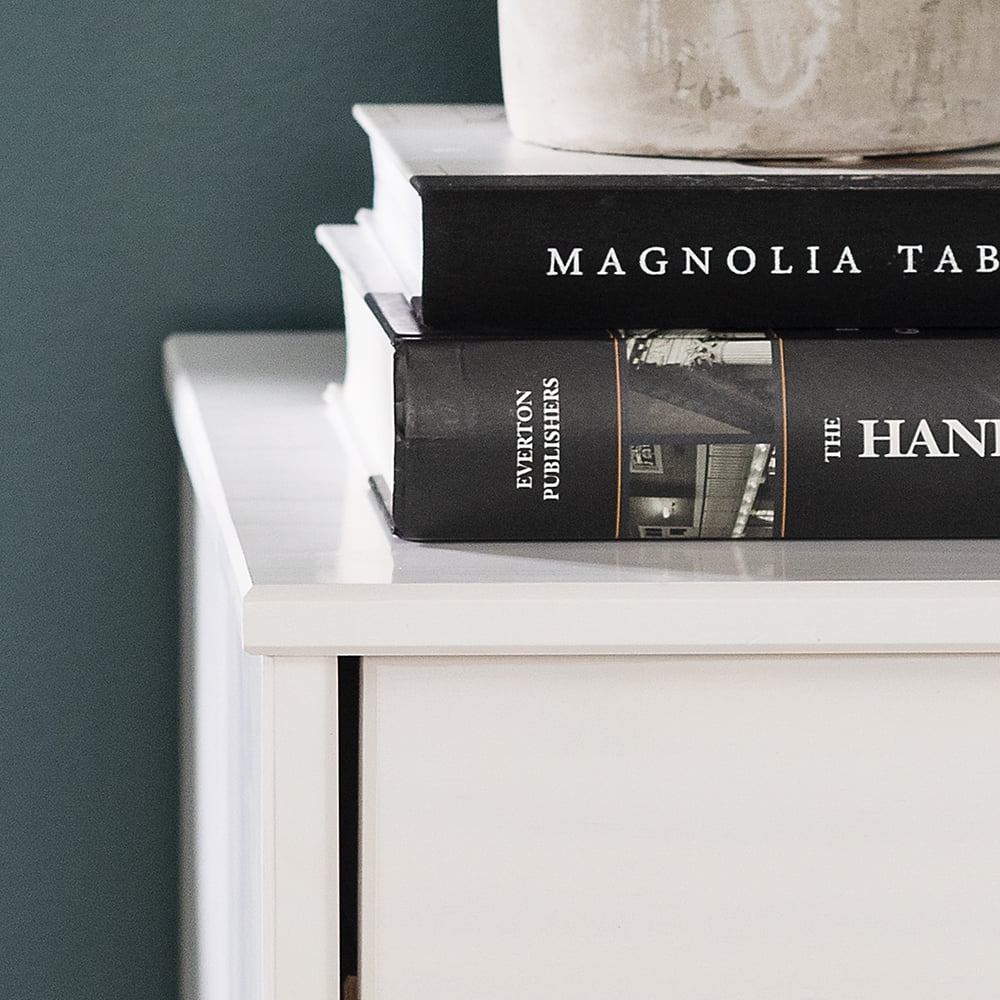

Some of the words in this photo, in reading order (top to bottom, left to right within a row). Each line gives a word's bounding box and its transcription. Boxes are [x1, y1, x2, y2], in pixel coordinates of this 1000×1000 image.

[546, 245, 862, 276] MAGNOLIA
[516, 389, 534, 489] EVERTON
[542, 377, 561, 501] PUBLISHERS
[823, 416, 842, 463] THE
